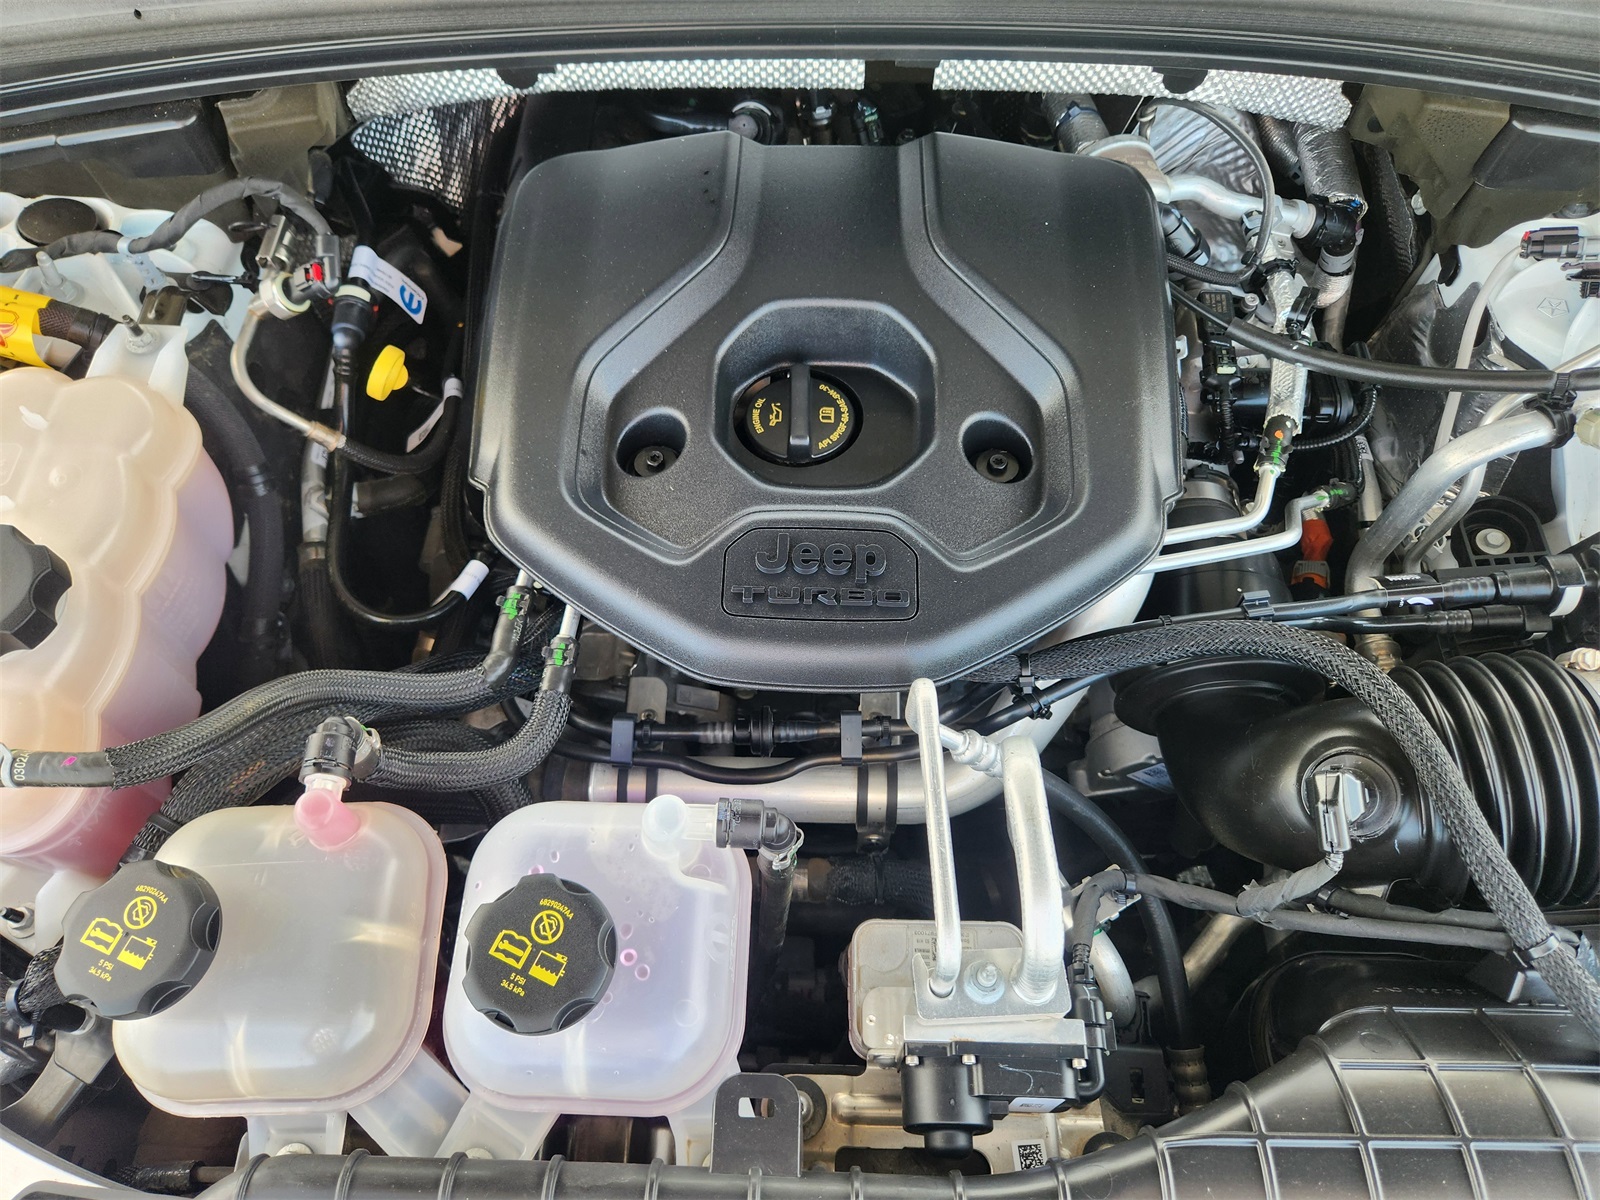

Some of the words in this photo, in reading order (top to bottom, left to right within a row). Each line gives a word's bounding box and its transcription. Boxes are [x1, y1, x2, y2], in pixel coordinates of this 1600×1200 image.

[755, 398, 766, 408] OIL
[752, 408, 765, 434] ENGINE
[818, 438, 832, 450] API
[755, 532, 887, 585] Jeep
[731, 585, 911, 608] TURBO
[98, 958, 105, 967] 5
[102, 961, 115, 971] PSI
[88, 966, 102, 977] 34.5
[100, 971, 112, 982] kPa
[509, 972, 516, 980] 5
[514, 975, 527, 985] PSI
[500, 979, 515, 991] 34.5
[513, 985, 525, 997] kPa
